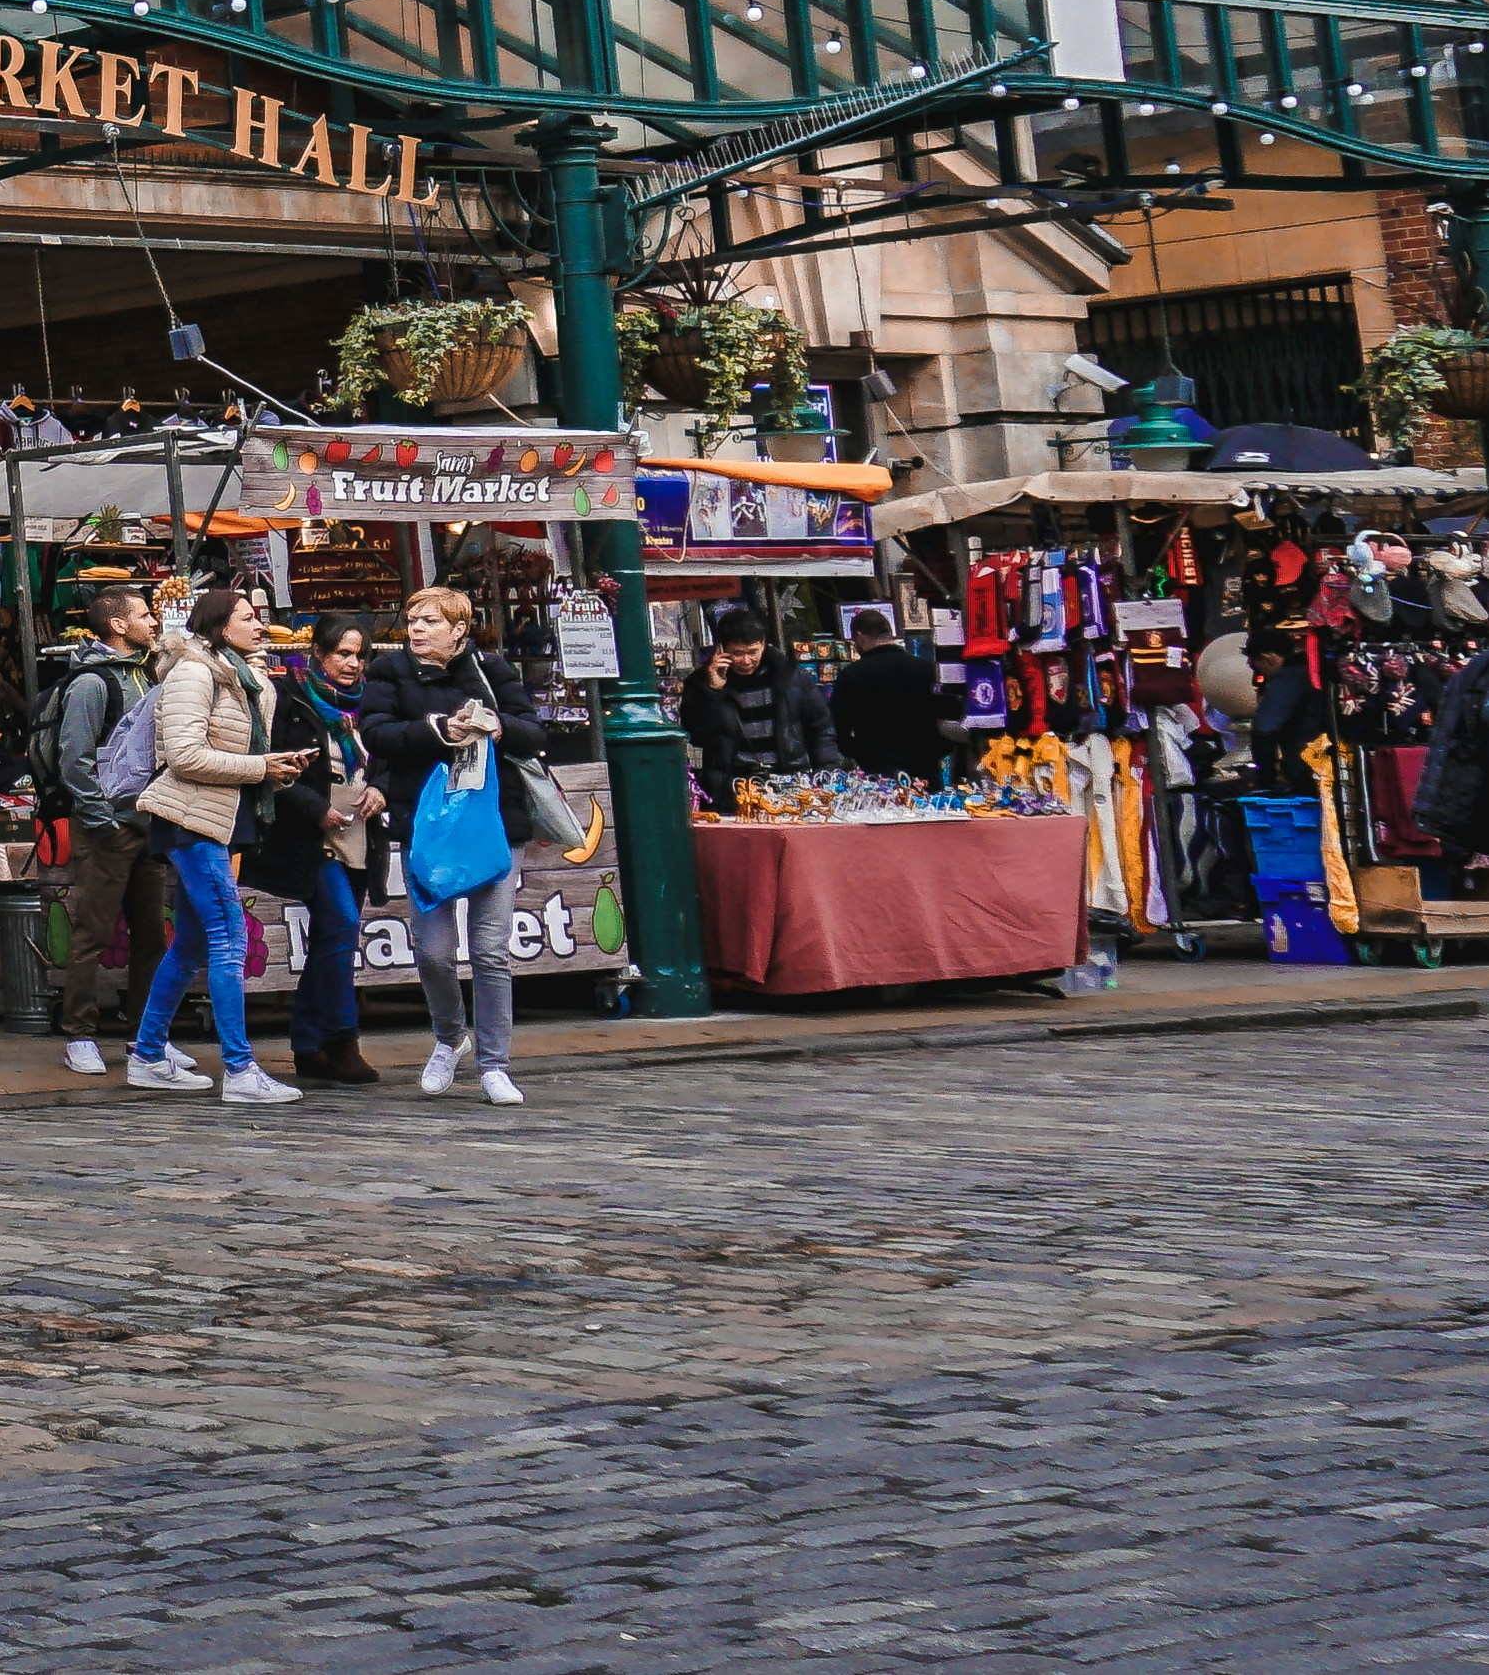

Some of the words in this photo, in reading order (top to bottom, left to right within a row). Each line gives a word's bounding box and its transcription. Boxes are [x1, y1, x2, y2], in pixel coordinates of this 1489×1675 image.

[228, 86, 441, 208] HALL
[433, 451, 476, 475] Sam's
[331, 470, 423, 503] Fruit
[431, 474, 552, 504] Market
[561, 611, 609, 623] Market
[567, 600, 600, 612] Fruit
